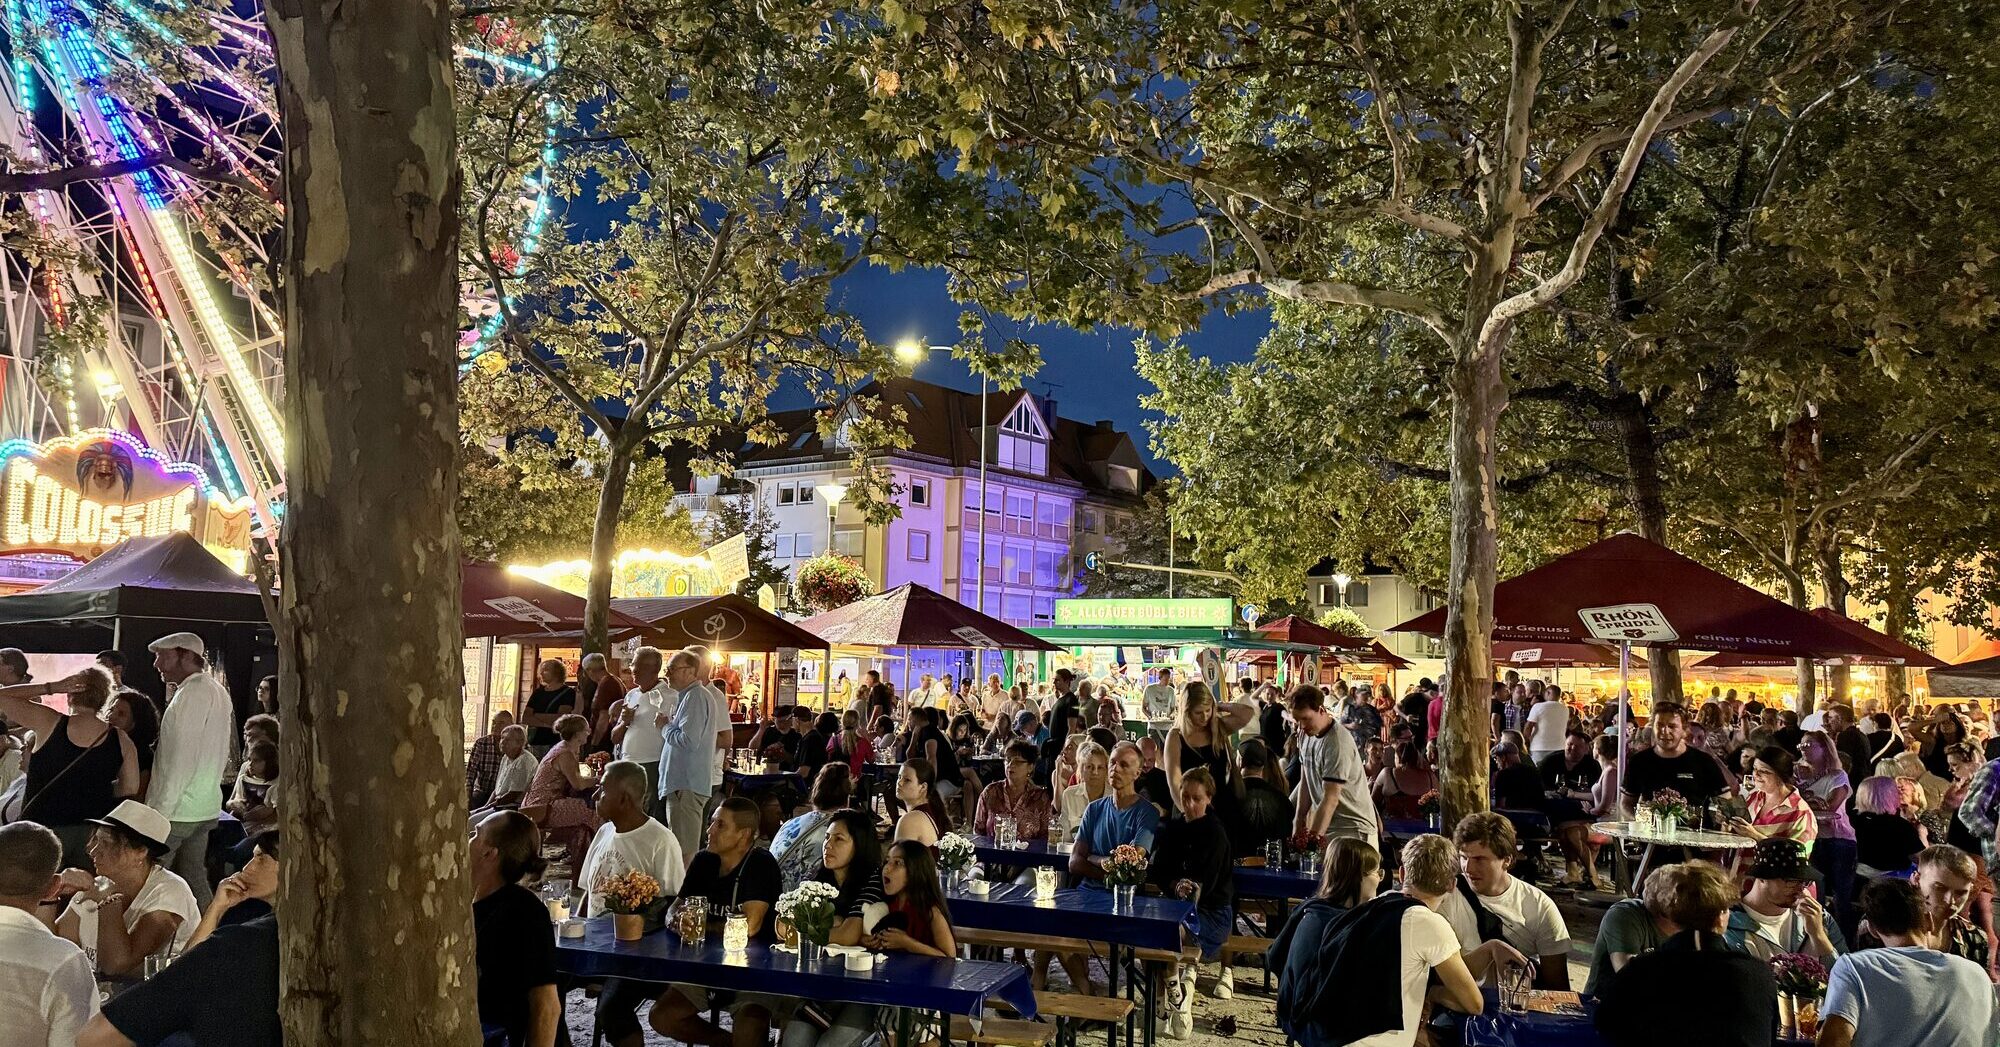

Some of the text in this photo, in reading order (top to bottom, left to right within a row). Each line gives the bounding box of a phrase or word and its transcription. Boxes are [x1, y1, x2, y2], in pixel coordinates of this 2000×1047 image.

[6, 456, 198, 545] COLOSSUS
[1078, 604, 1206, 619] ALLGÄUER BÜBLE BIER
[1591, 609, 1653, 622] RHÖN
[1516, 625, 1570, 633] Genuss
[1597, 620, 1660, 629] SPRUDEL
[1694, 634, 1741, 643] reiner
[1746, 637, 1792, 645] Natur
